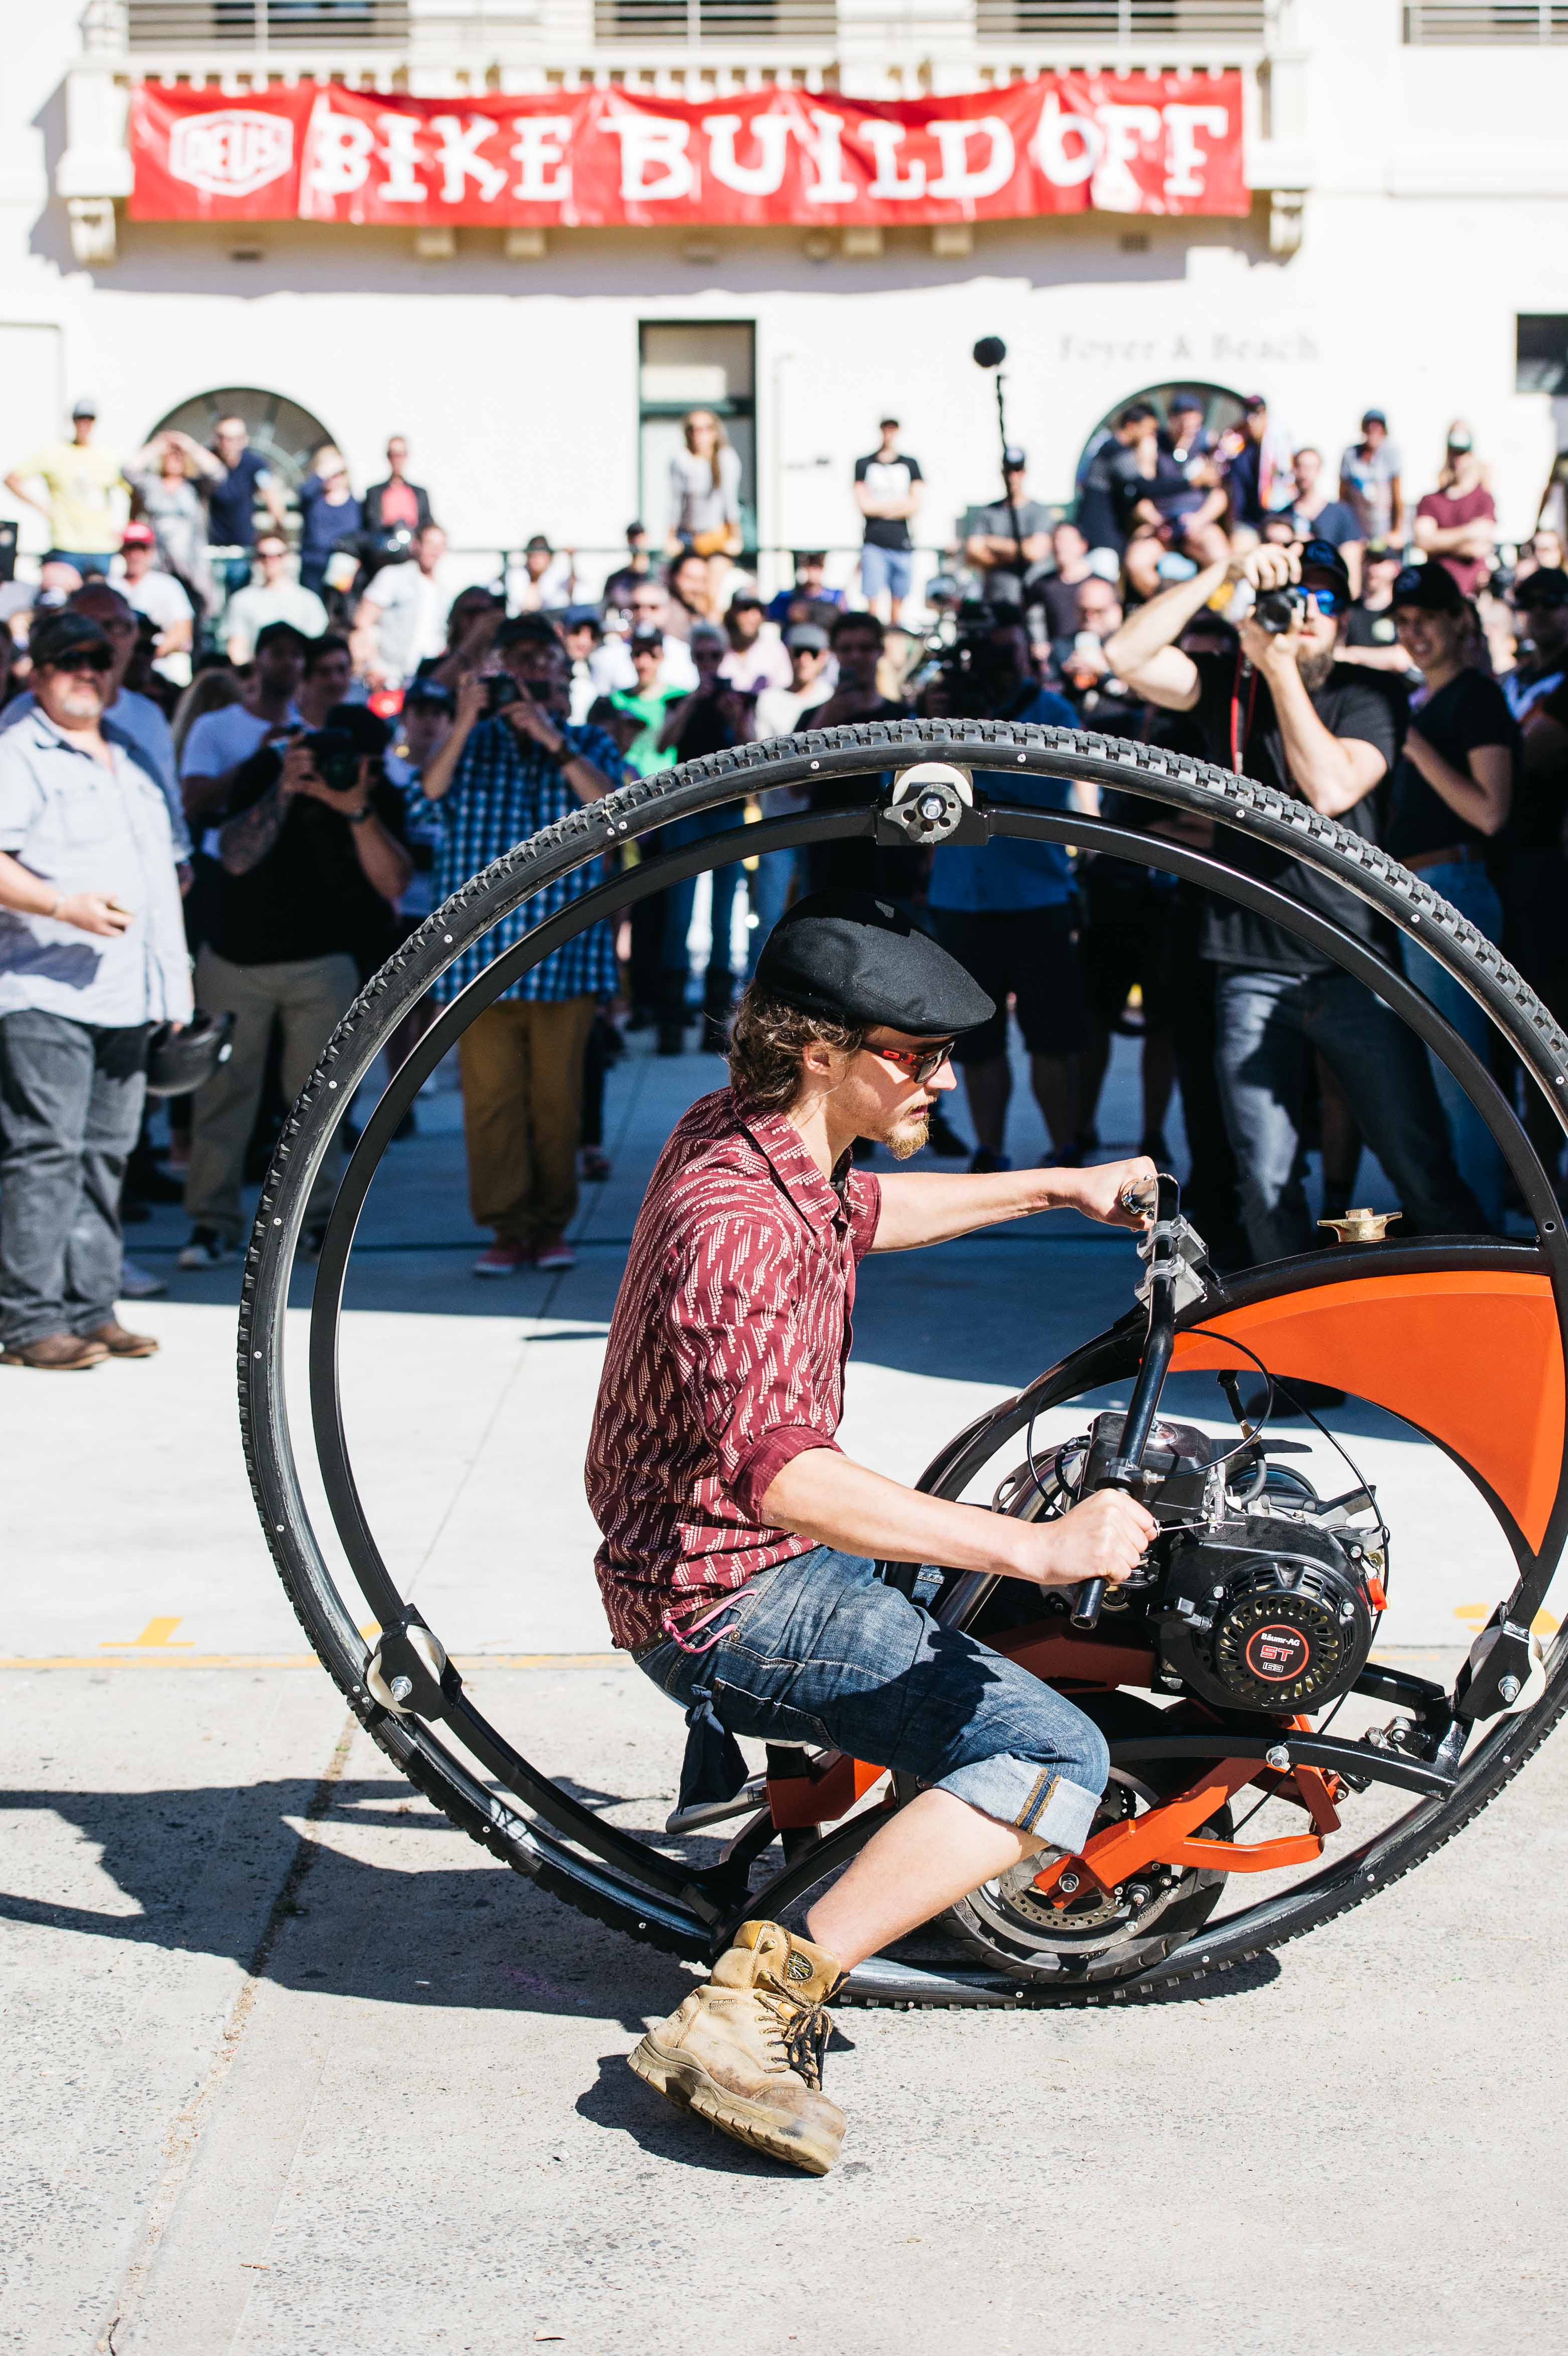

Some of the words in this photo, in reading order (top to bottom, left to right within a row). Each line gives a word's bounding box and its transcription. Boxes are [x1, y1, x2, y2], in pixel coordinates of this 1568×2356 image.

[186, 118, 281, 182] DEUS
[308, 112, 572, 203] BIKE
[597, 112, 1016, 203] BUILD
[1029, 103, 1228, 199] OFF
[1211, 329, 1320, 362] Beach
[1260, 1645, 1294, 1661] ST
